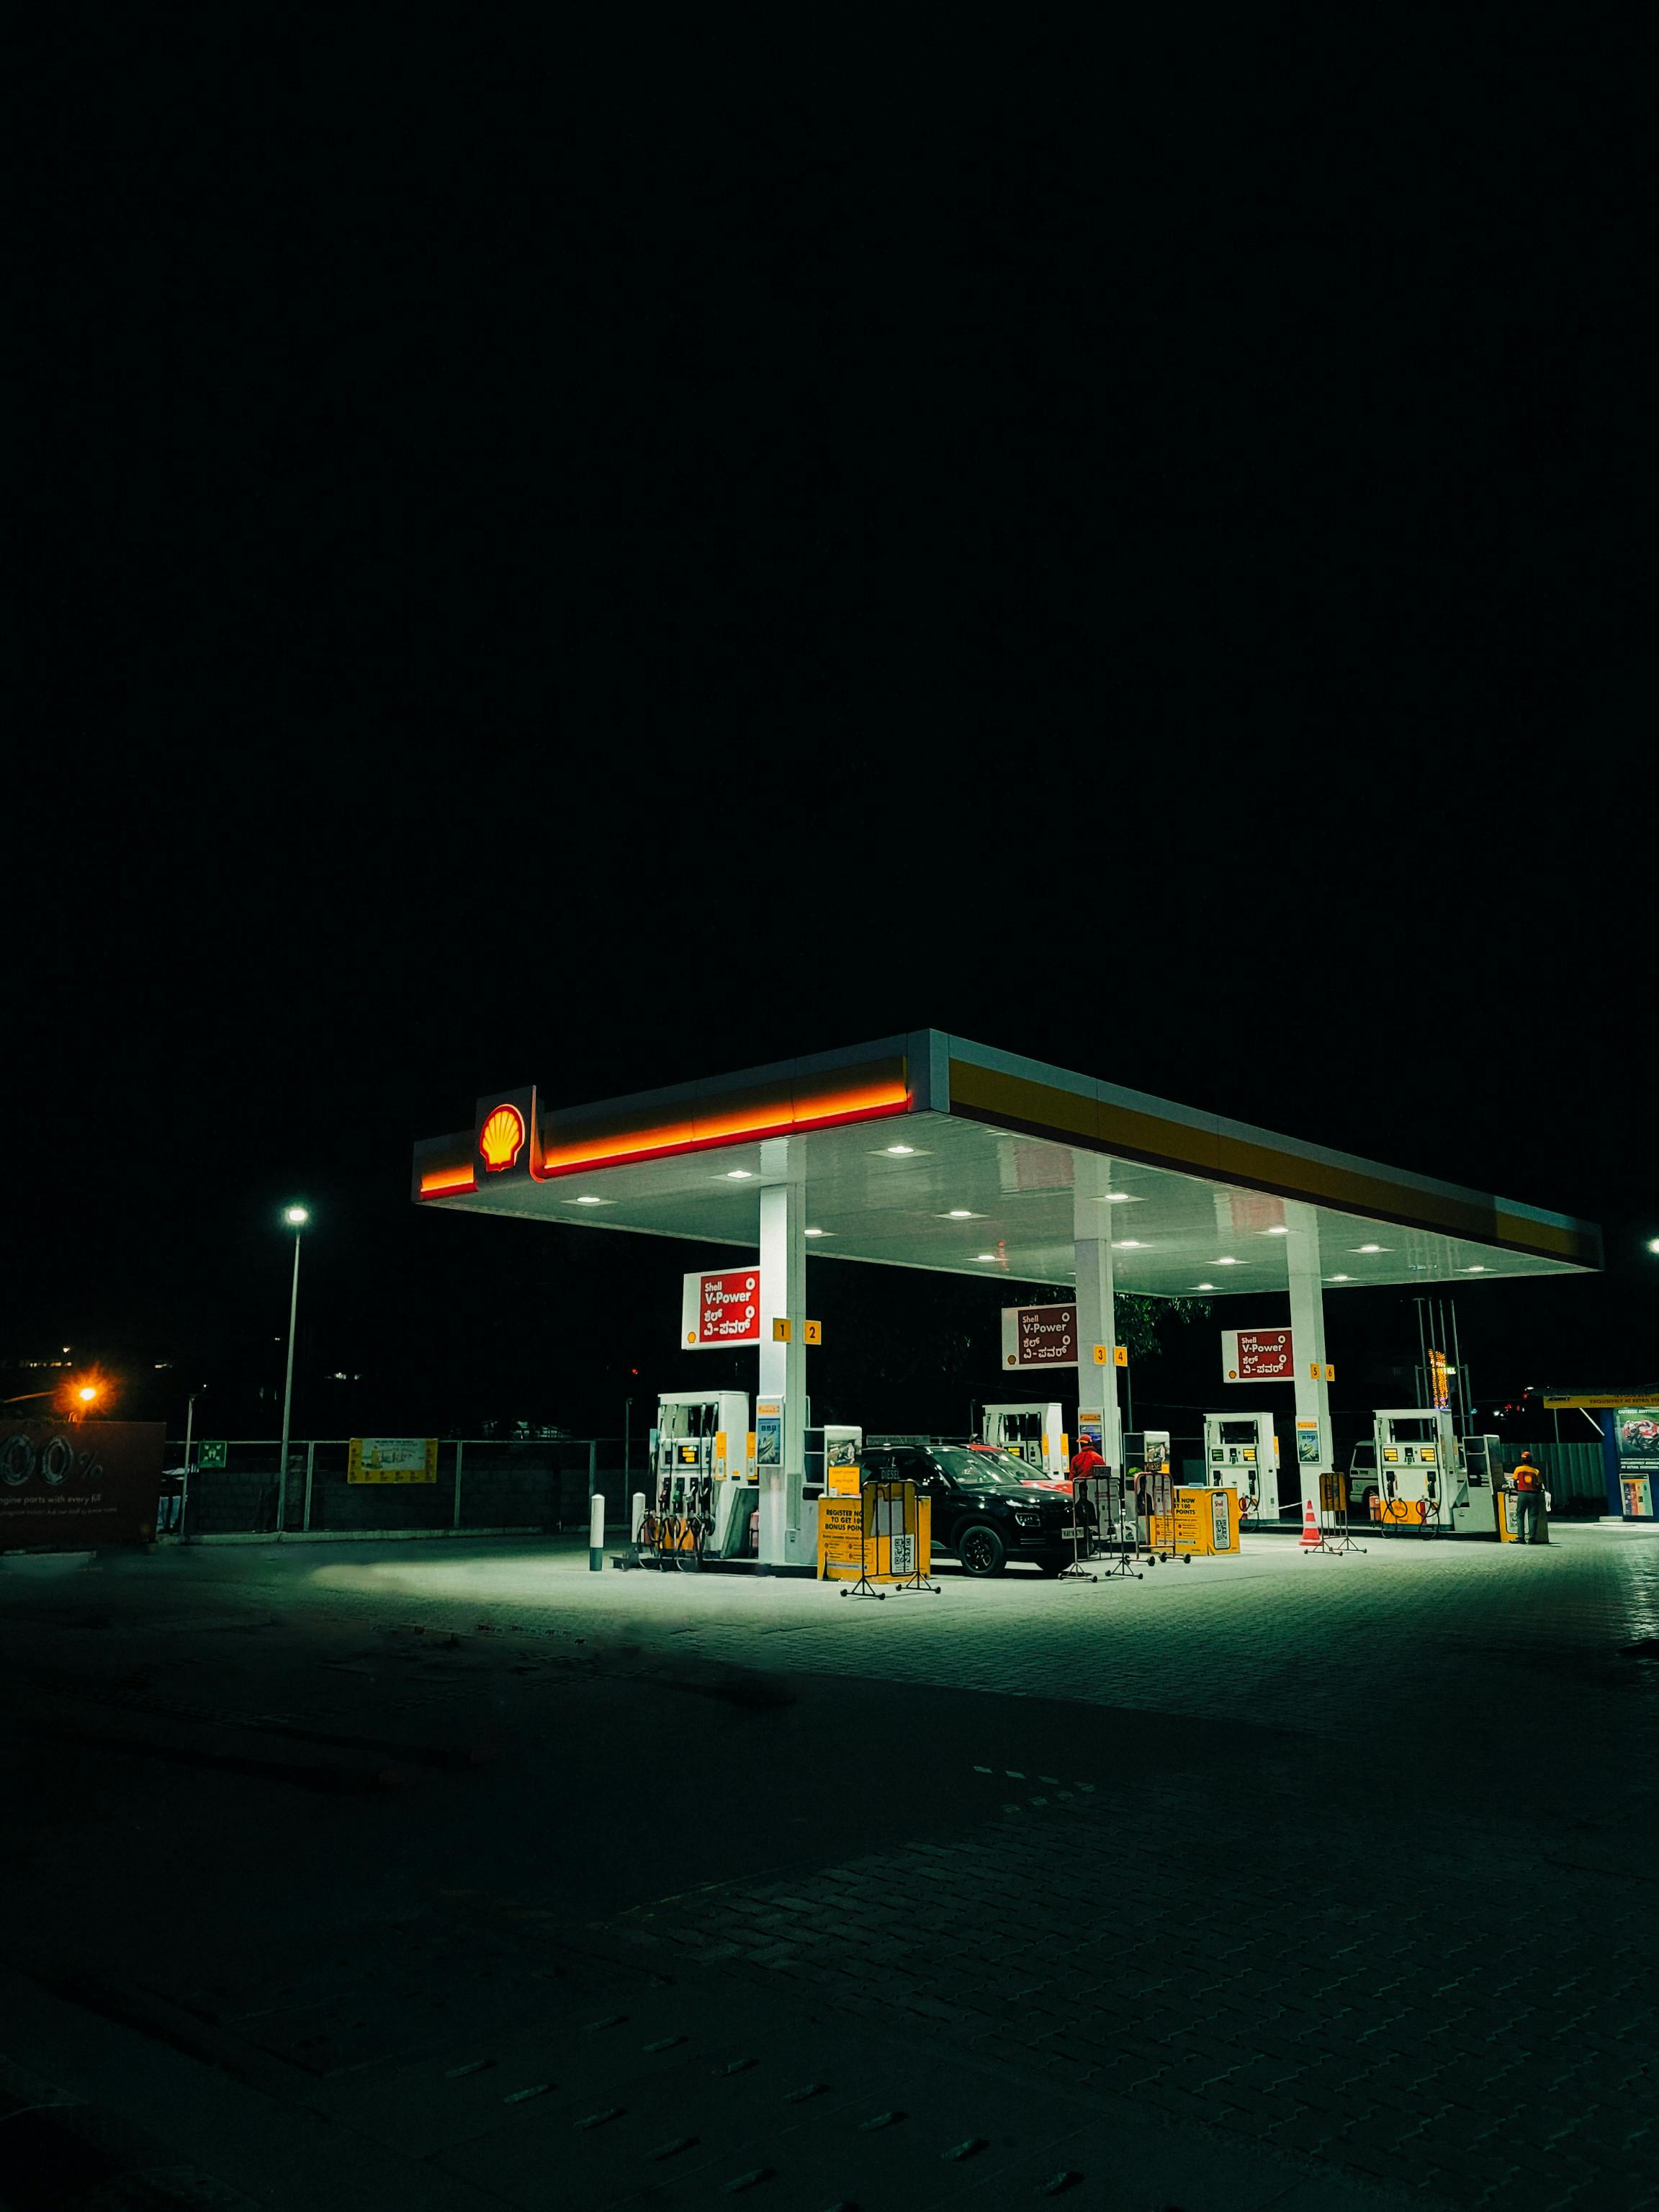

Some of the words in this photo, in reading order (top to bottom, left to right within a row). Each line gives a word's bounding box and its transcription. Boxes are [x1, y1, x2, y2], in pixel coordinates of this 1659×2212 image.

[705, 1282, 722, 1292] Shell
[705, 1292, 751, 1305] V-Power
[1022, 1314, 1038, 1323] Shell
[780, 1324, 784, 1336] 1
[809, 1326, 815, 1339] 2
[1023, 1323, 1066, 1334] V-Power
[1242, 1344, 1283, 1353] V-Power
[1098, 1349, 1102, 1360] 3
[1118, 1352, 1123, 1361] 4
[1313, 1367, 1317, 1376] 5
[1328, 1368, 1332, 1377] 6
[881, 1470, 900, 1480] DIESEL
[24, 1497, 45, 1506] parts
[48, 1495, 66, 1503] with
[68, 1497, 89, 1506] every
